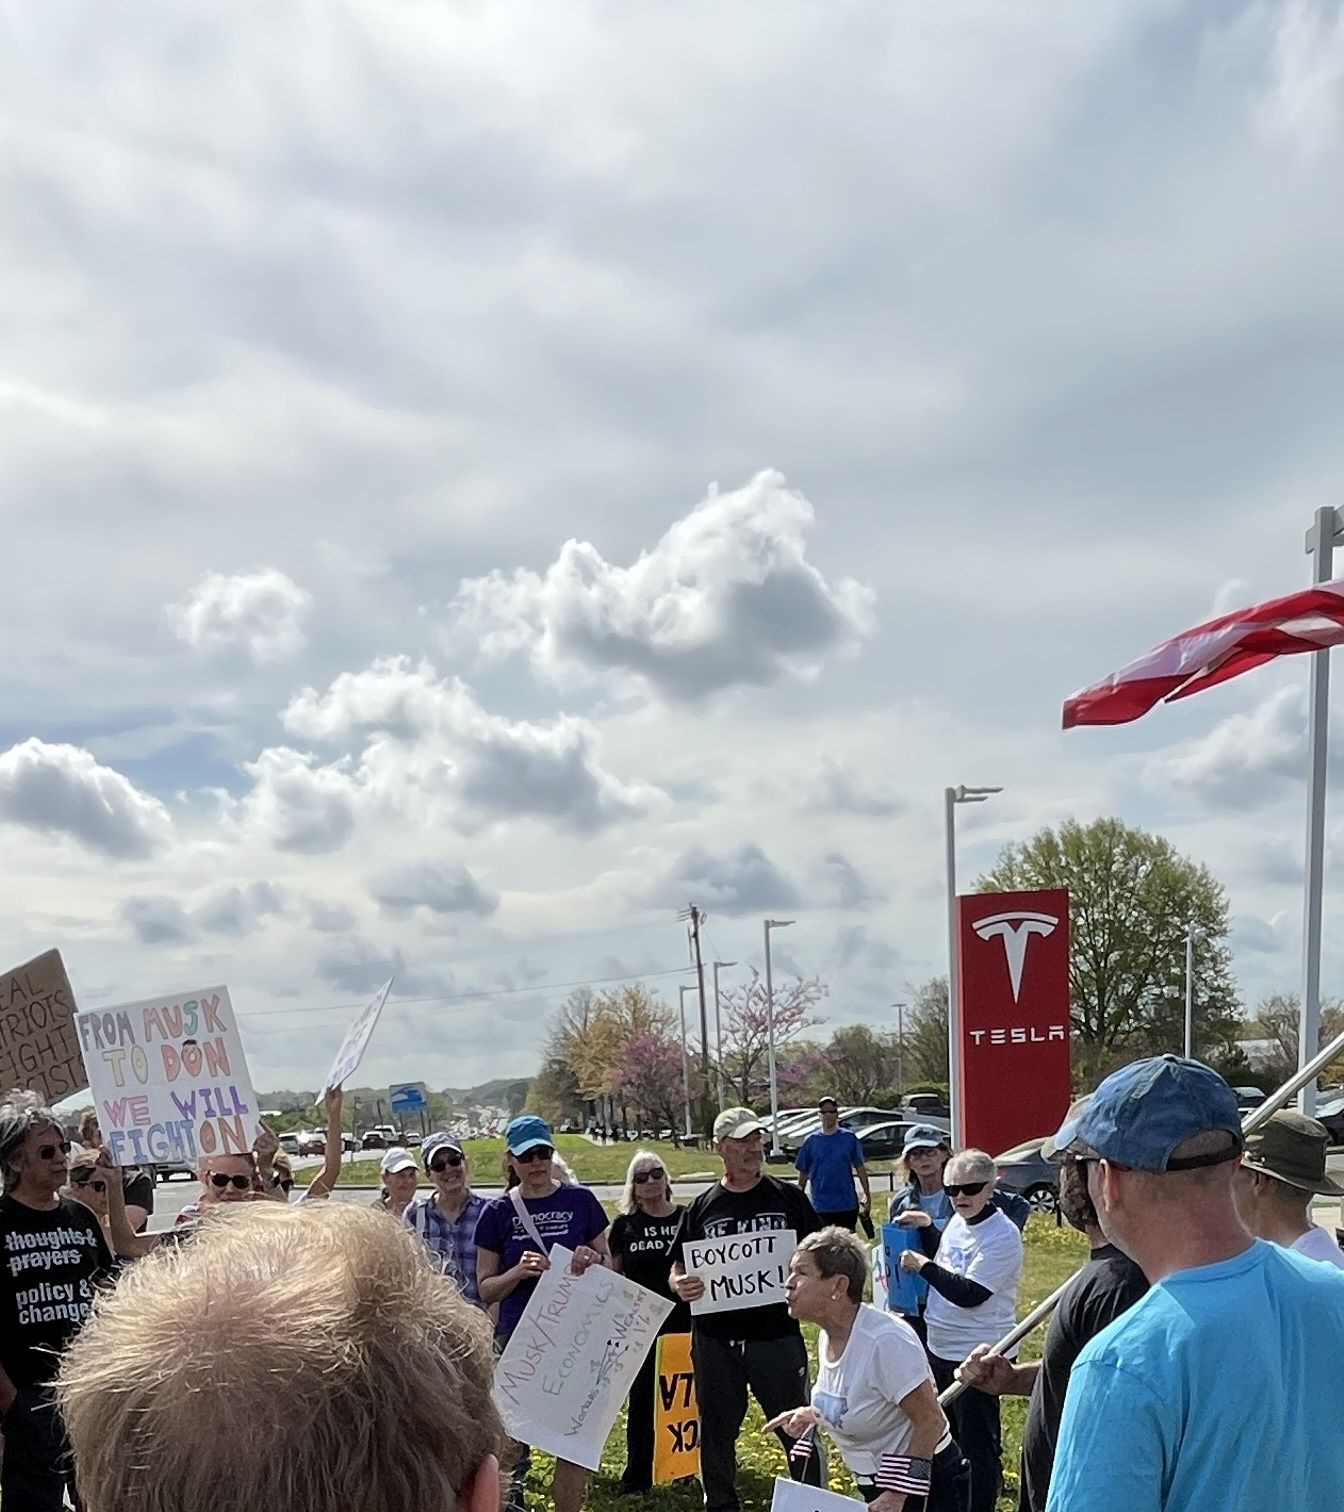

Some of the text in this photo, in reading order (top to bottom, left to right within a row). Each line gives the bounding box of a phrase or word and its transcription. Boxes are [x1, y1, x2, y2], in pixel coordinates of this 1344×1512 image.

[78, 994, 227, 1052] FROM MUSK
[969, 1025, 1064, 1046] TESLA
[102, 1037, 231, 1088] TO DON
[103, 1085, 249, 1128] WE WILL
[109, 1115, 248, 1167] FIGHT ON
[4, 1227, 97, 1251] thoughts &
[630, 1240, 664, 1252] DEAD
[644, 1227, 658, 1237] IS
[6, 1249, 82, 1277] prayers
[692, 1236, 777, 1269] BOYCOTT
[16, 1279, 92, 1310] policy &
[710, 1265, 785, 1302] MUSK!
[18, 1302, 90, 1325] change
